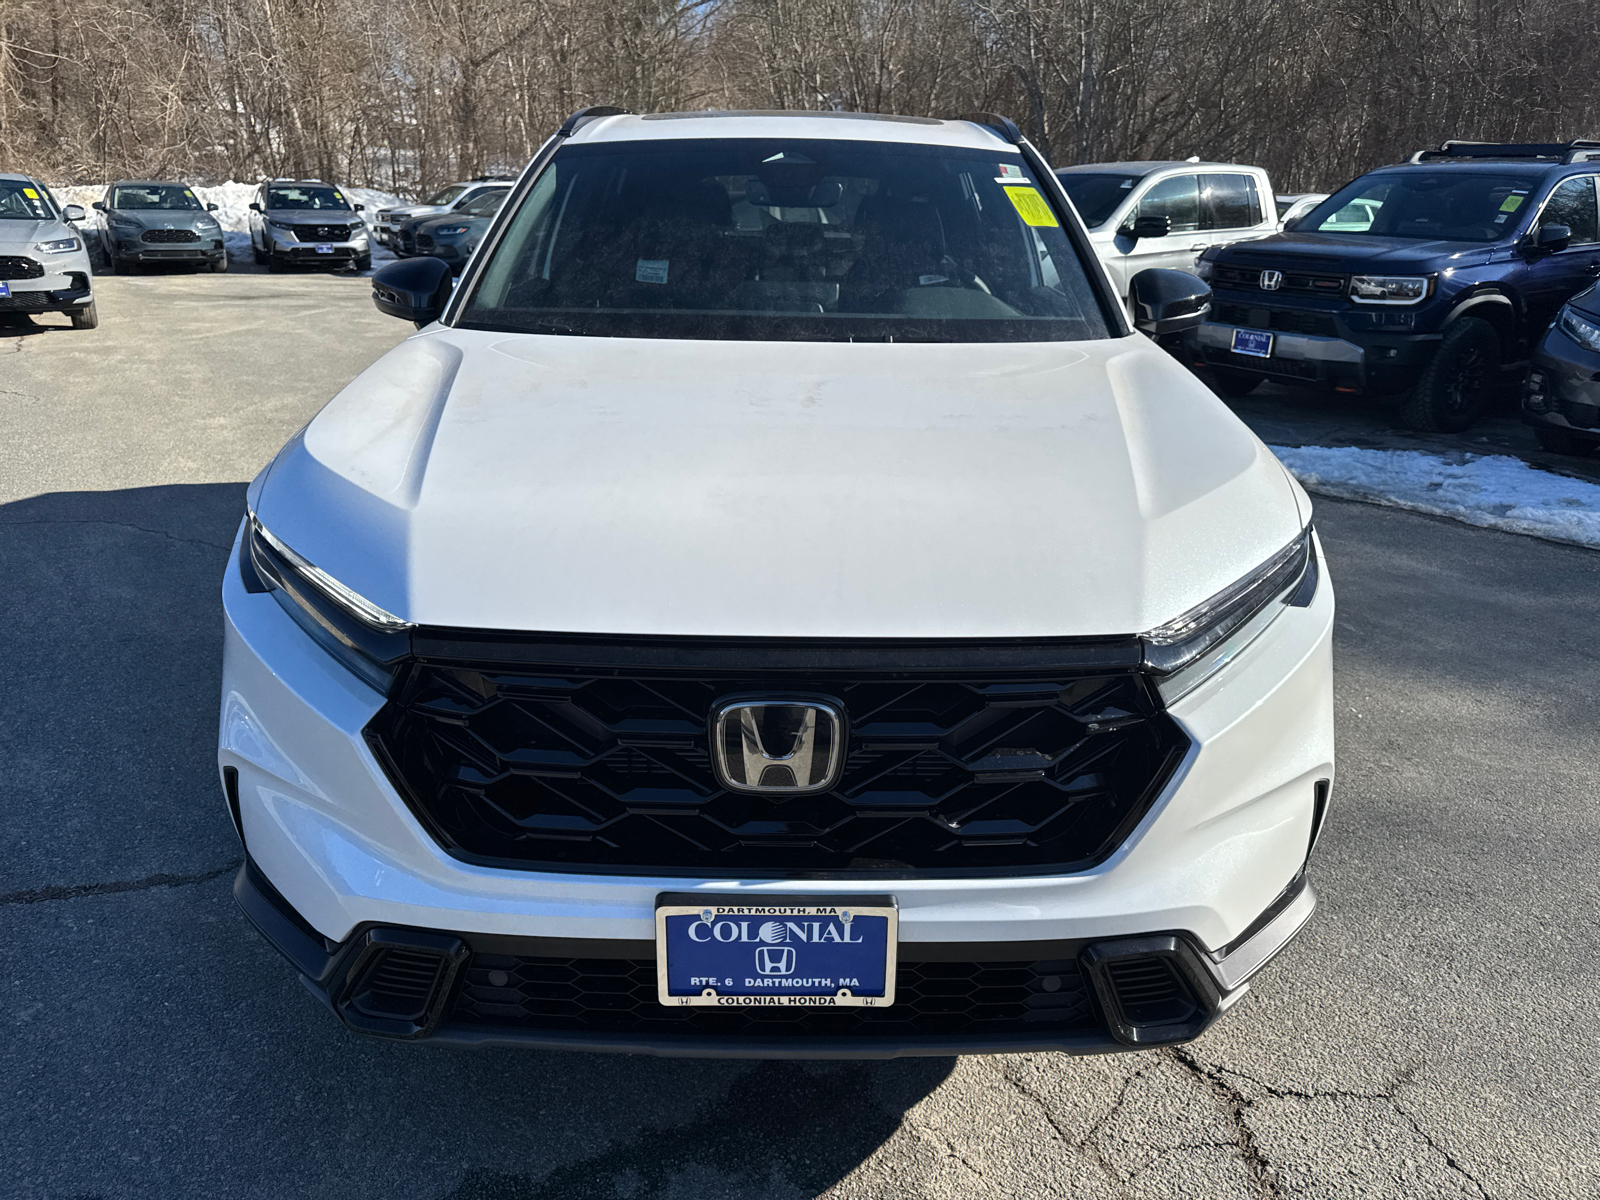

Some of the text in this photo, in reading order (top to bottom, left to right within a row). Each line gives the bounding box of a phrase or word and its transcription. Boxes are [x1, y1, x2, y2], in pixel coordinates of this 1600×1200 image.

[716, 907, 838, 915] DARTMOUTH, MA
[687, 921, 863, 944] COLONIAL
[690, 977, 860, 988] RTE. 6 DARTMOUTH, MA
[717, 997, 837, 1005] COLONIAL HONDA
